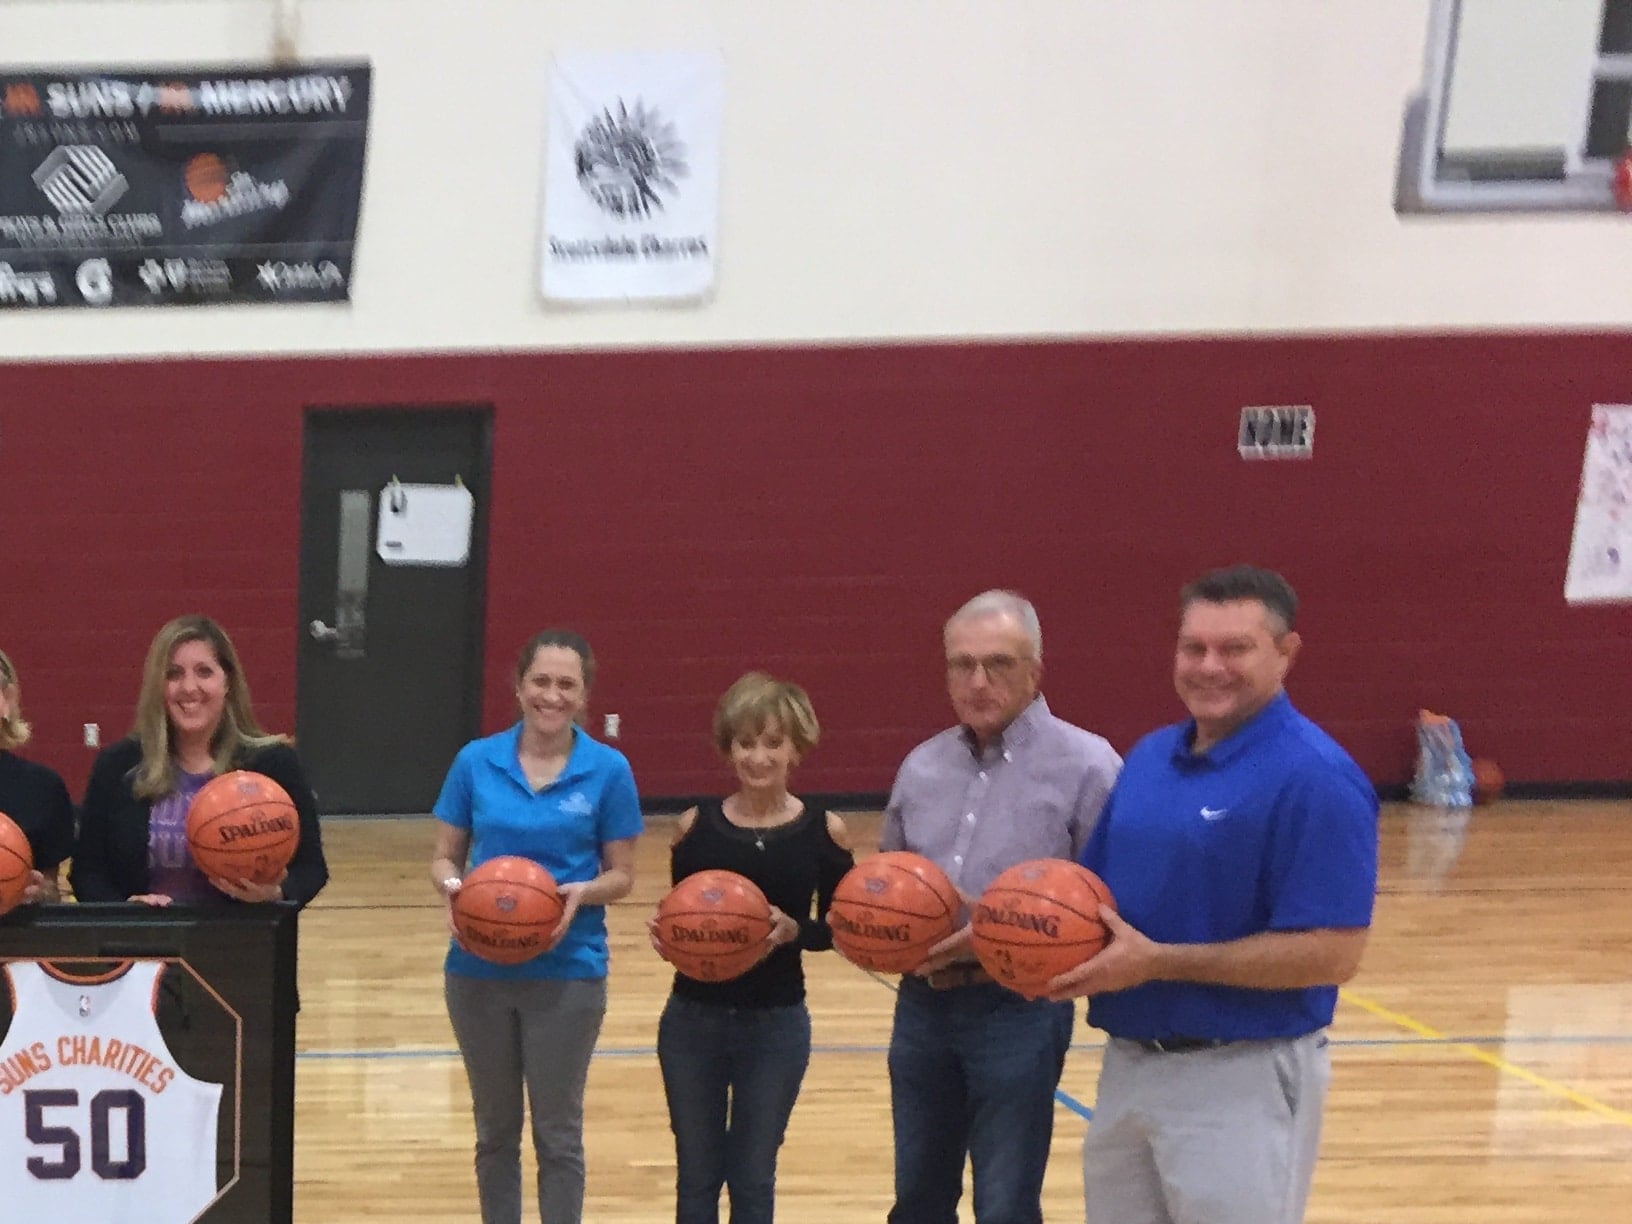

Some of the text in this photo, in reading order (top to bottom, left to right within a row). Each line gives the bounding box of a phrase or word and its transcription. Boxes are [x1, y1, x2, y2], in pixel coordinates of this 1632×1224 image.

[47, 81, 134, 118] SUNS
[199, 76, 353, 116] MERCURY
[1241, 407, 1310, 449] HOME
[56, 1035, 176, 1095] CHARITIES
[22, 1089, 147, 1181] 50
